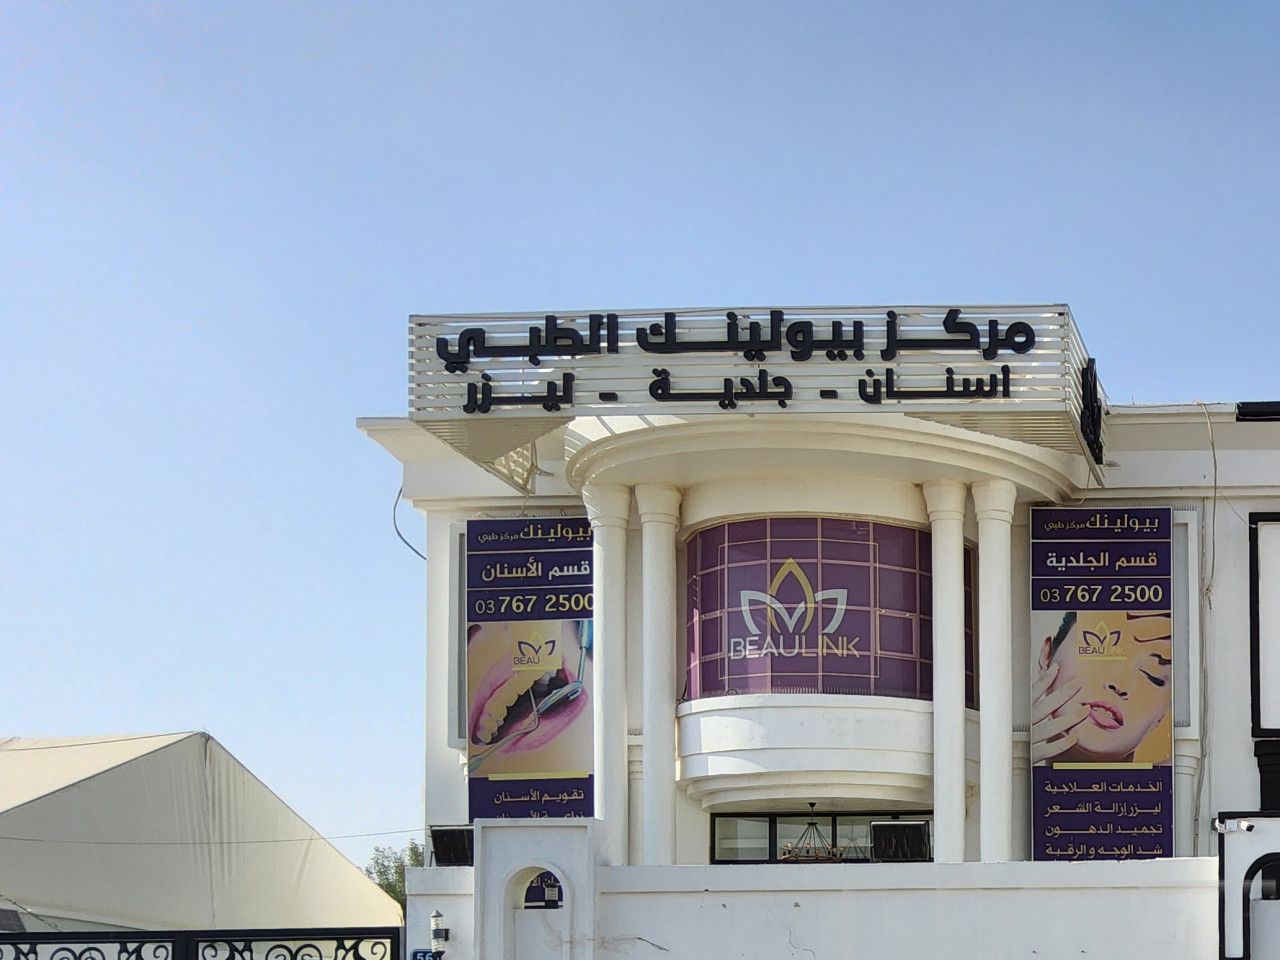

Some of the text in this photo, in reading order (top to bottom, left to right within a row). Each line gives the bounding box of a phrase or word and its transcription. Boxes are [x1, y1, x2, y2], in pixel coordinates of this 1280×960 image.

[436, 309, 1035, 373] مركز بيولينك الطبي
[463, 372, 574, 413] ليزر
[650, 368, 793, 409] جلدية
[1086, 514, 1159, 532] بيولينك
[481, 556, 590, 581] قسم الأسنان
[1046, 552, 1158, 571] قسم الجلدية
[475, 594, 593, 614] 03 767 2500
[1040, 585, 1163, 602] 03 767 2500
[730, 635, 860, 660] BEAULINK
[542, 789, 584, 804] تقويم
